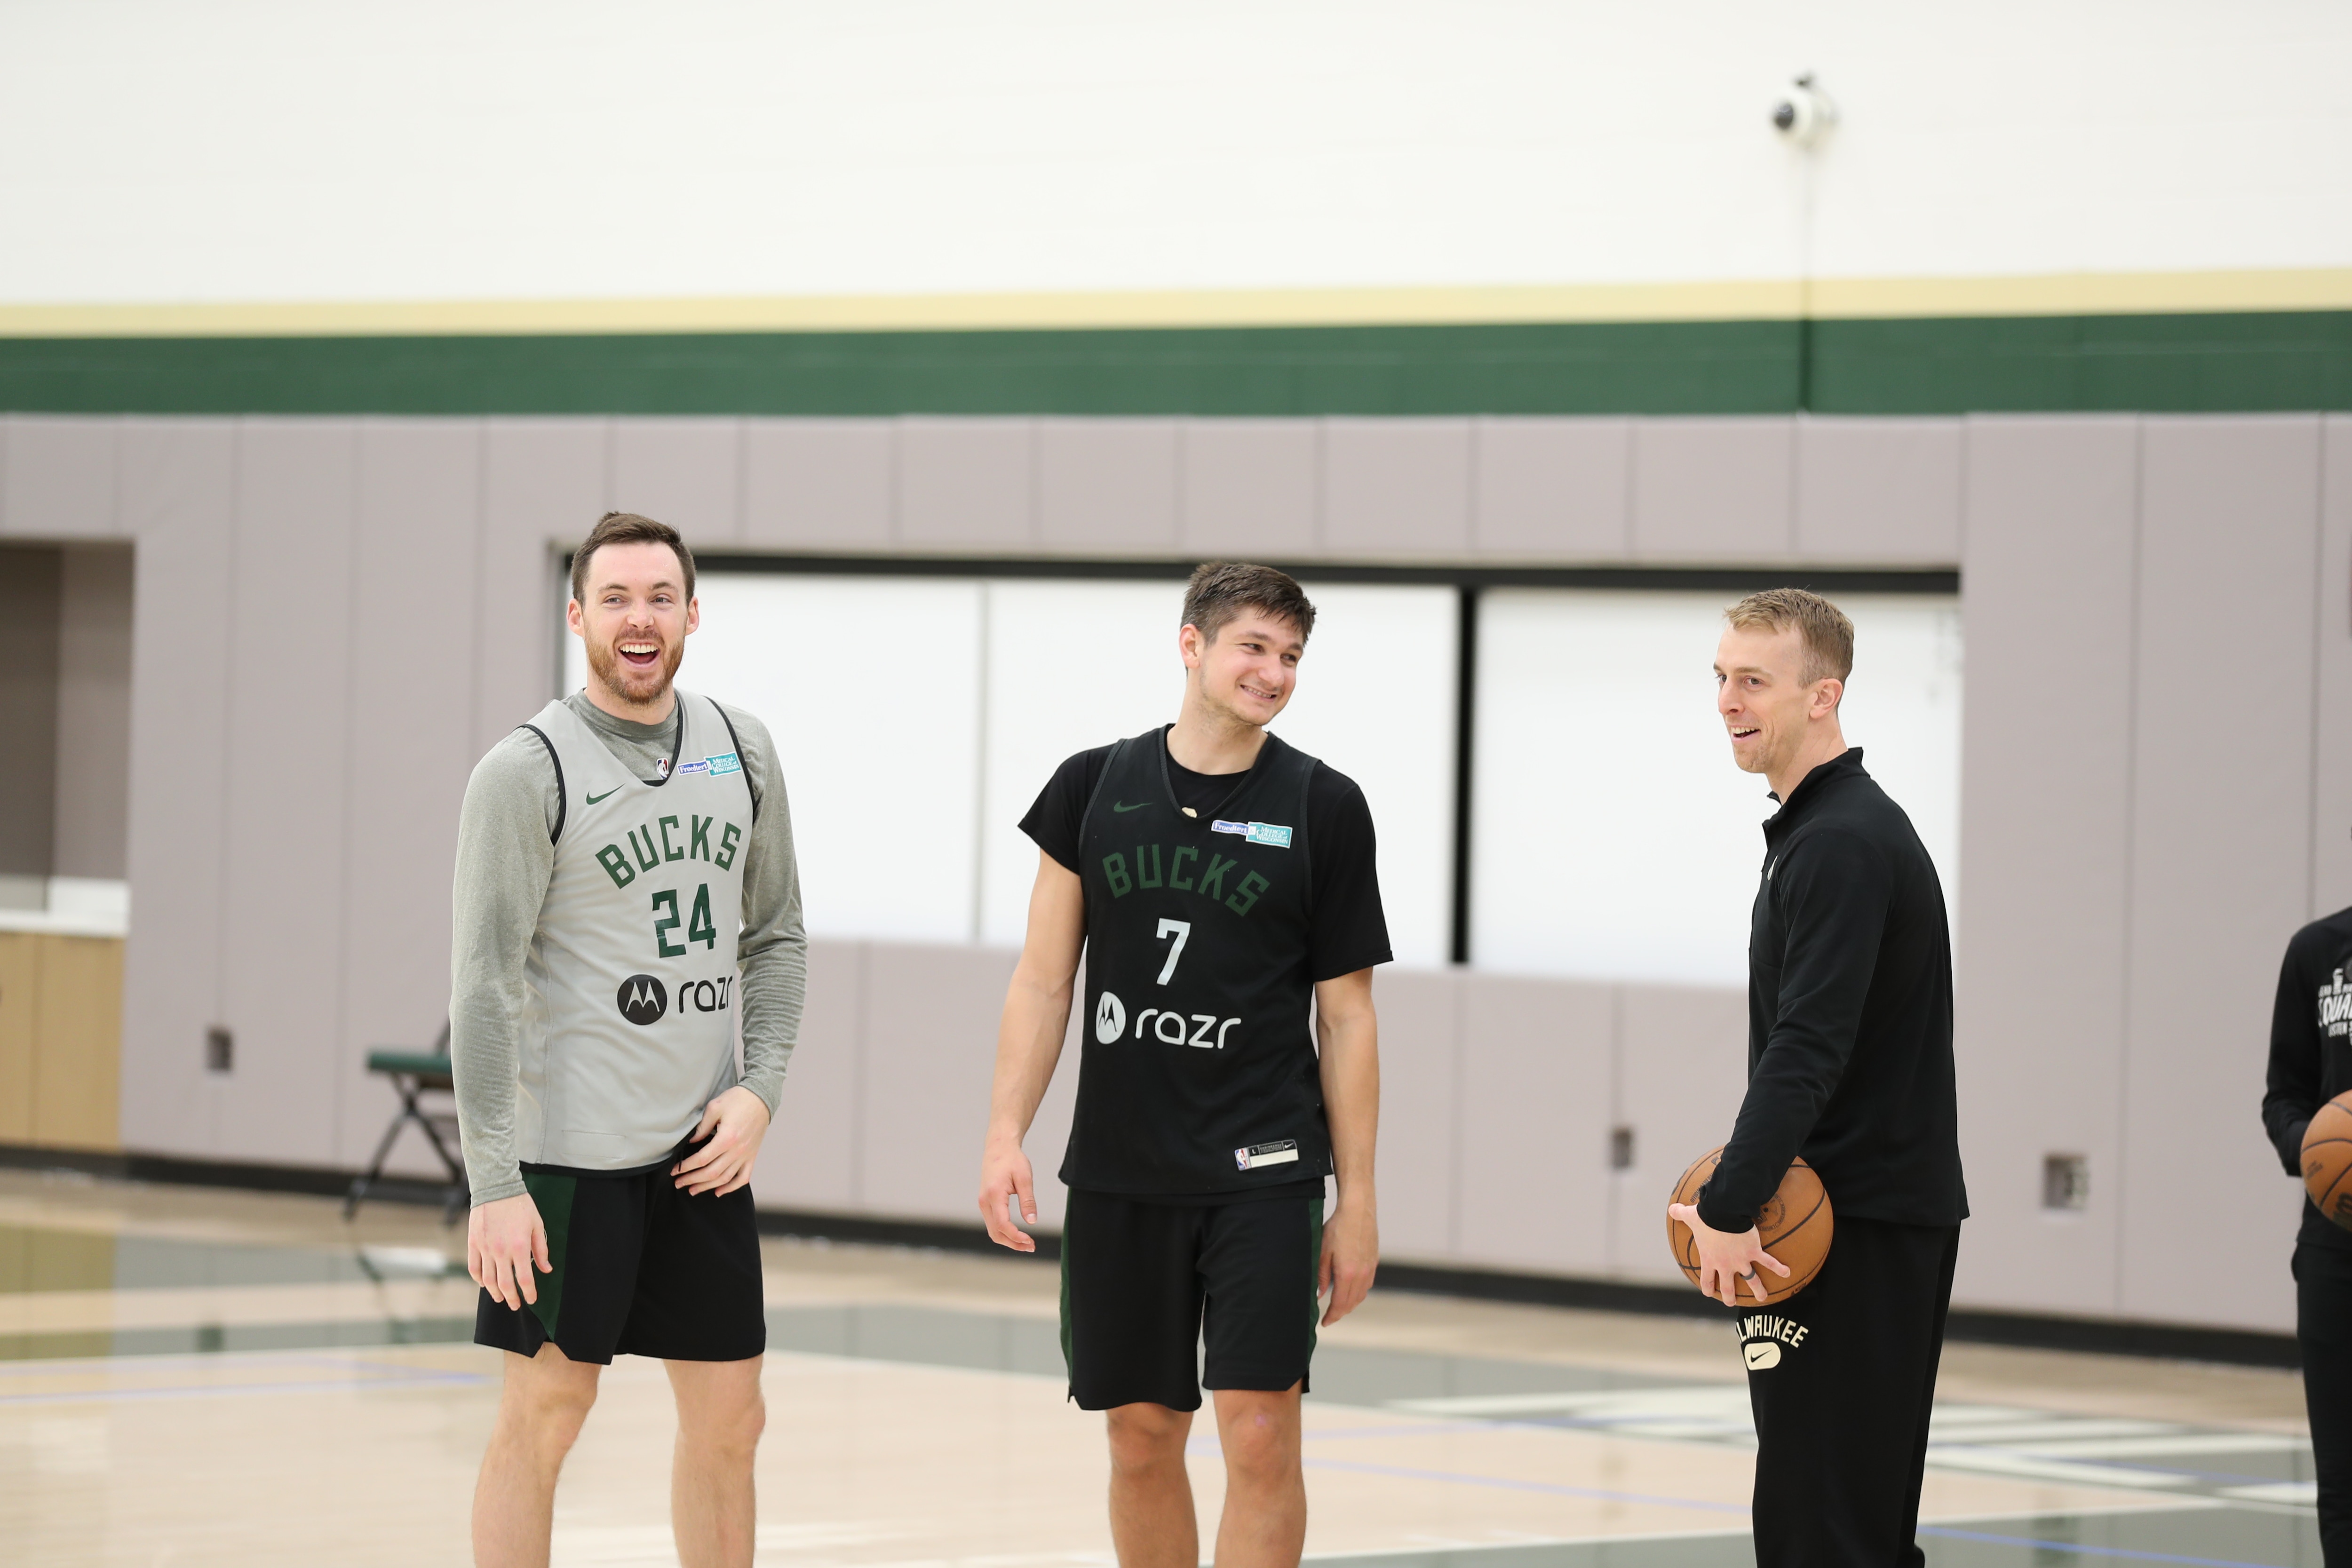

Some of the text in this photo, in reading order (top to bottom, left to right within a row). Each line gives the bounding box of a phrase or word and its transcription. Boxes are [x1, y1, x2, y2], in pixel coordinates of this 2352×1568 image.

[679, 763, 707, 773] Froedtert
[1214, 822, 1248, 834] Froedtert
[1256, 835, 1288, 844] WISCONSIN
[1261, 826, 1287, 835] MEDICAL
[595, 815, 741, 889] BUCKS
[1102, 844, 1270, 916] BUCKS
[652, 883, 716, 958] 24
[1156, 918, 1191, 986] 7
[679, 975, 733, 1013] razr
[1135, 1008, 1241, 1049] razr
[1736, 1315, 1809, 1348] LWAUKEE
